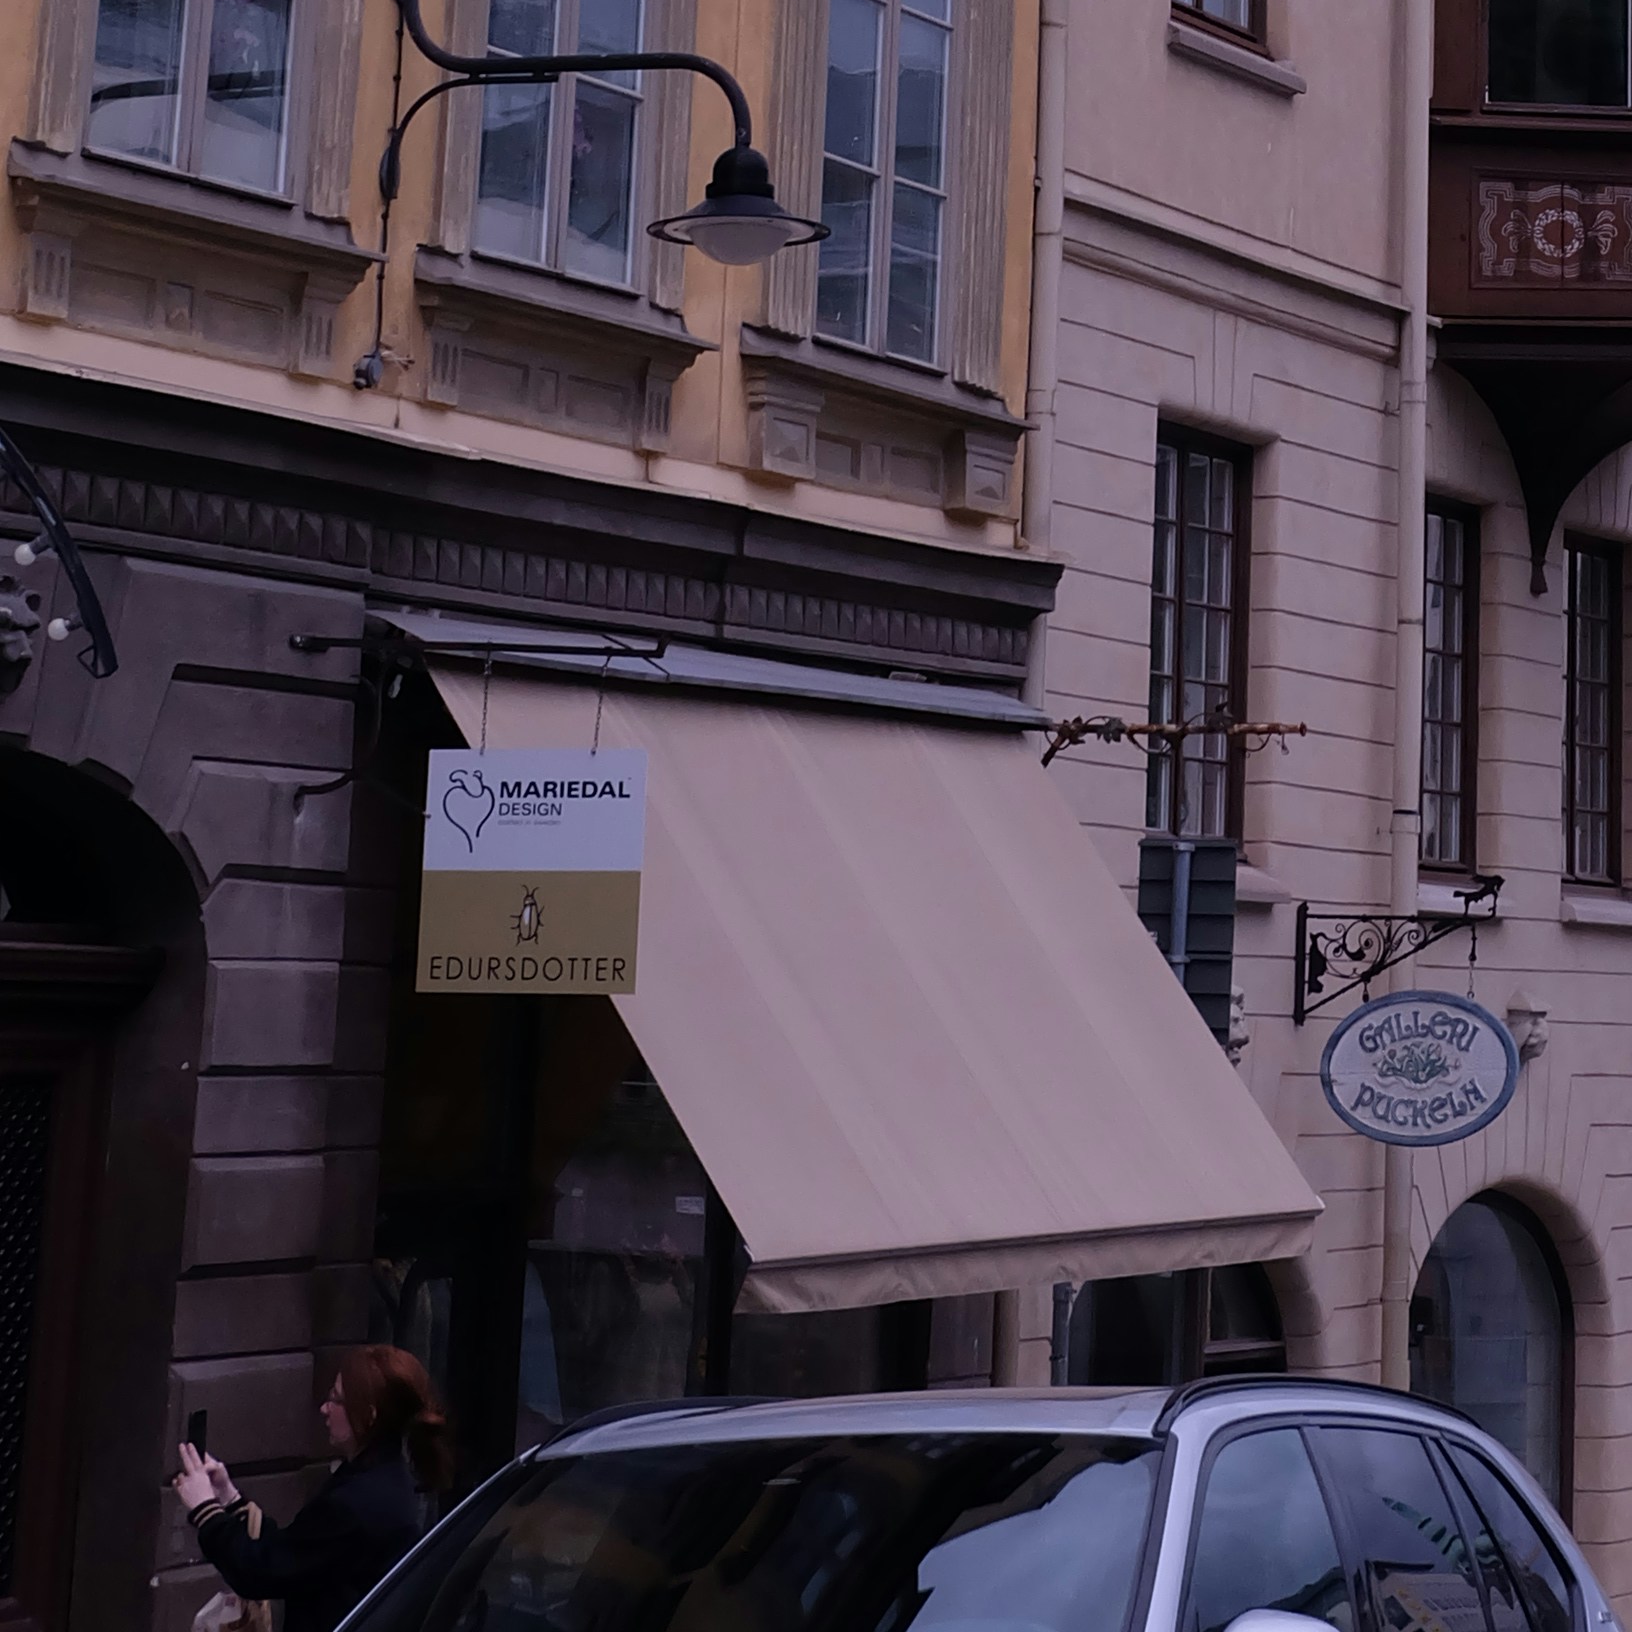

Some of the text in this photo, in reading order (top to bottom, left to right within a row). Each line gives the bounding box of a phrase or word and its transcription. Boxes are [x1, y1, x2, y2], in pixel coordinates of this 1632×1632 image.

[500, 781, 631, 798] MARIEDAL
[498, 802, 562, 816] DESIGN
[429, 956, 626, 982] EDURSDOTTER
[1358, 1010, 1480, 1053] GALLERI
[1350, 1078, 1488, 1129] PUCKELN
